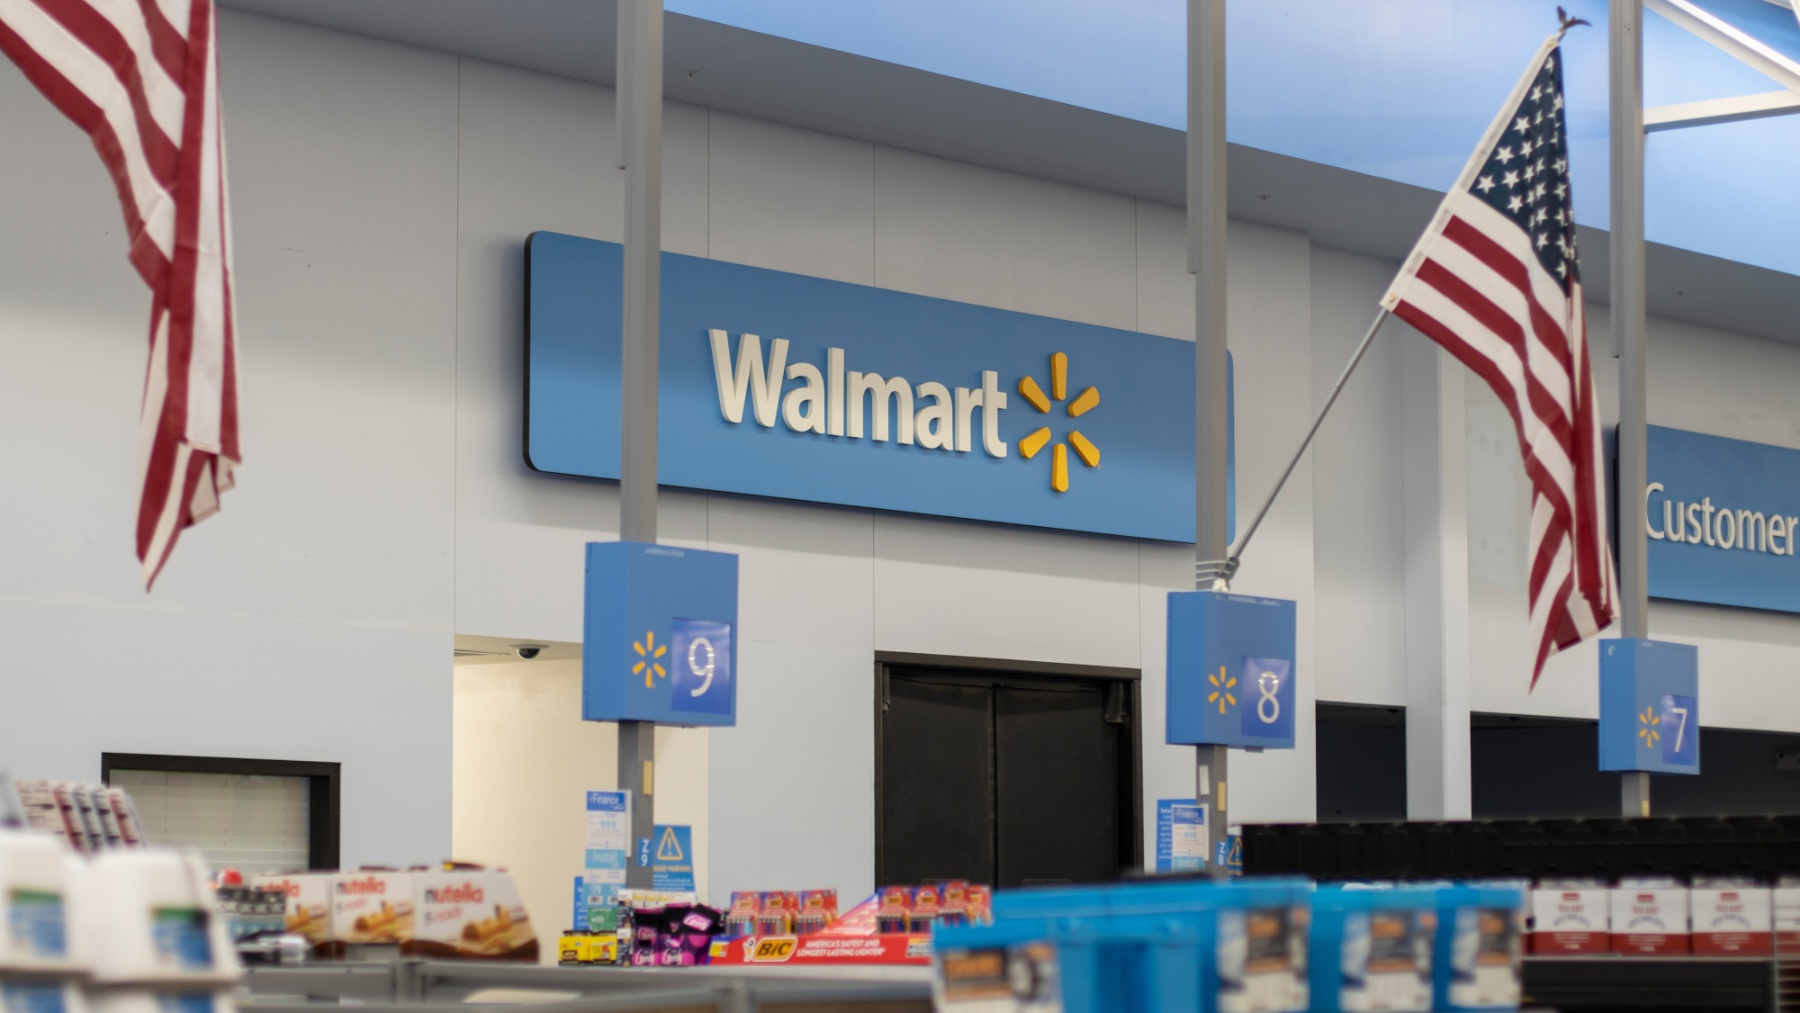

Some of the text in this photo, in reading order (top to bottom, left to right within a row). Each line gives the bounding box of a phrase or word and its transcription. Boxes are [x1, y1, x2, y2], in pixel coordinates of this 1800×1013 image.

[708, 328, 1007, 458] Walmart
[1646, 482, 1798, 555] Customer
[688, 637, 715, 697] 9
[1257, 671, 1280, 724] 8
[1672, 708, 1687, 752] 7
[336, 877, 386, 896] nutella
[425, 883, 484, 905] nutella
